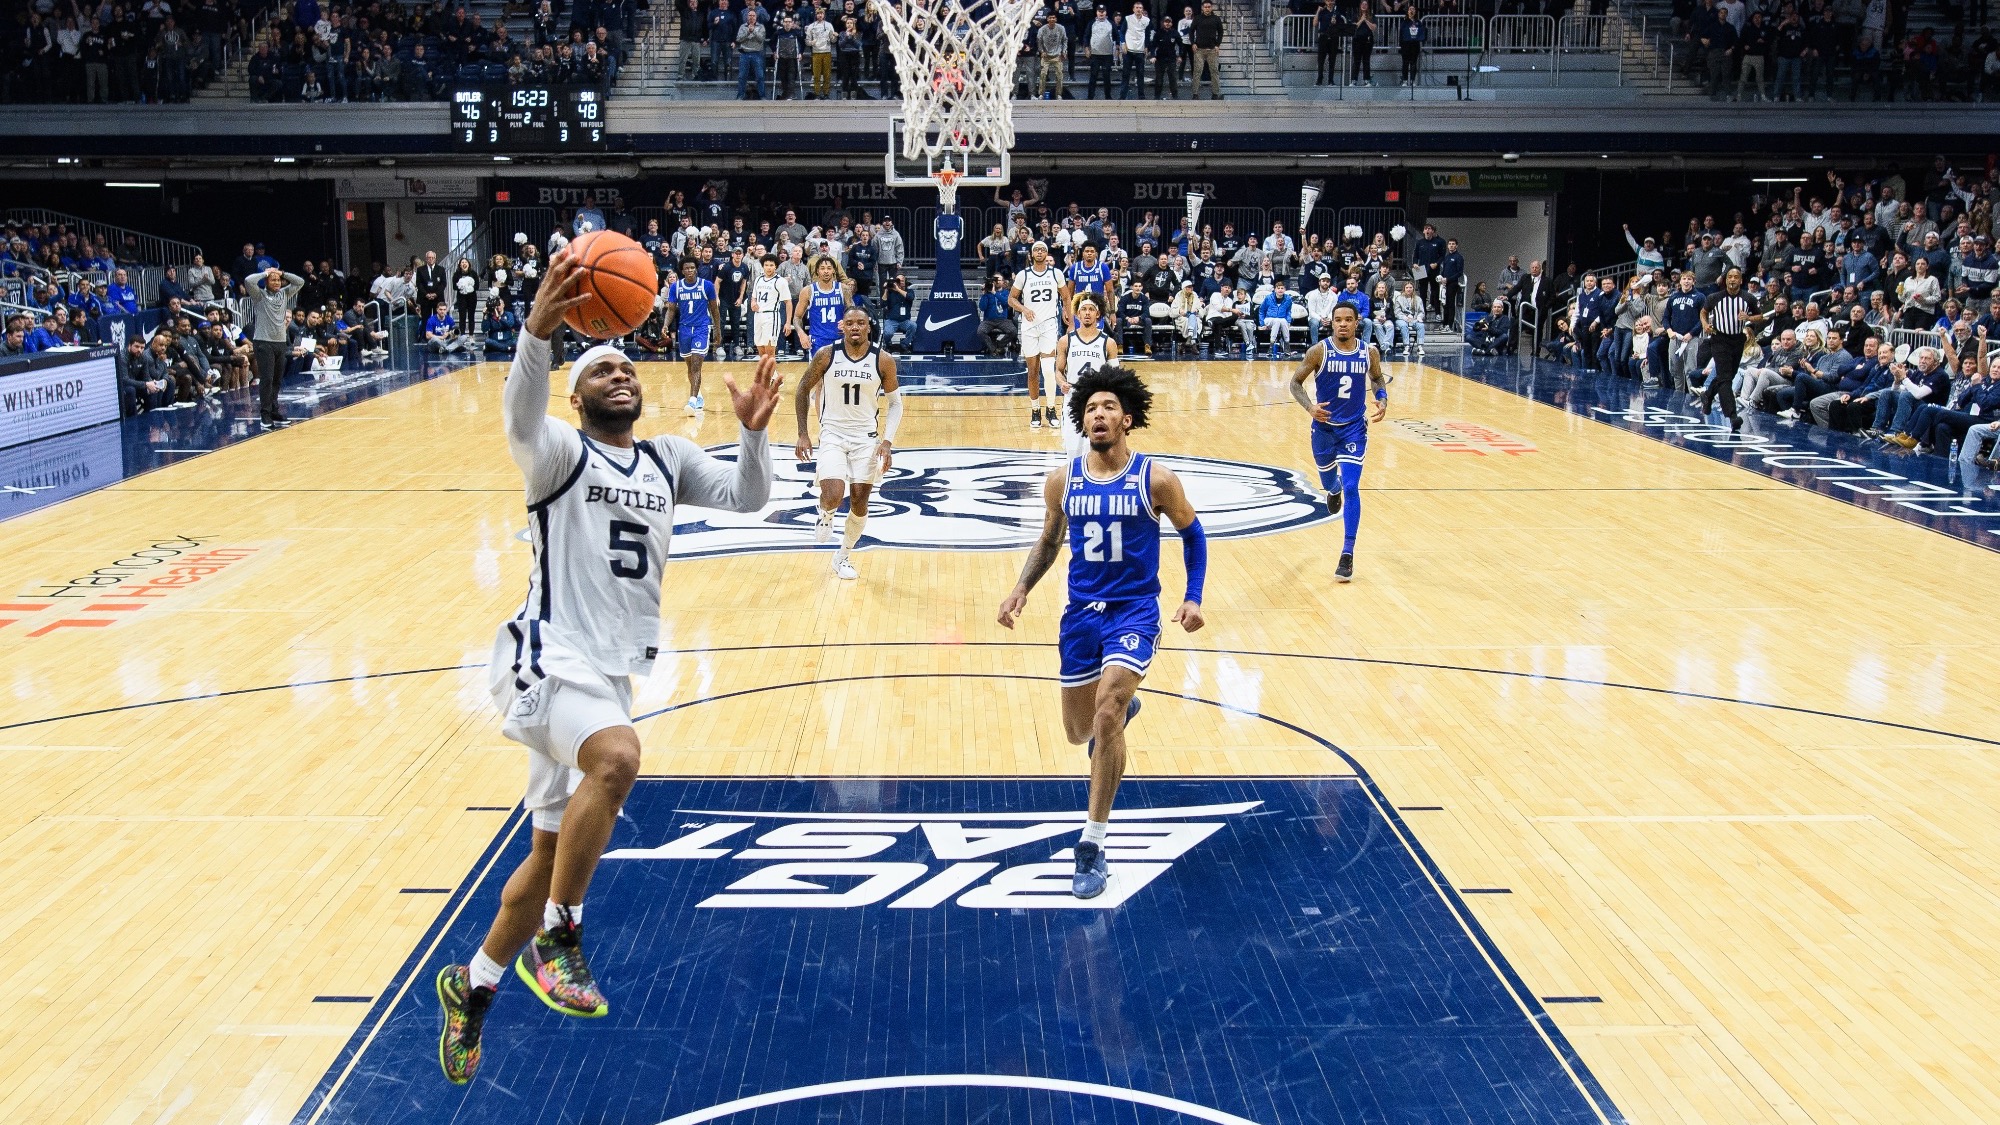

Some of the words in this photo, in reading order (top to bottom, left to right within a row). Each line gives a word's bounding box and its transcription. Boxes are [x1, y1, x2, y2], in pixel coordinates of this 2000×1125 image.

[456, 92, 482, 102] BUTLER
[512, 90, 548, 107] 15:23
[580, 92, 594, 102] SHU
[461, 105, 480, 119] 46
[524, 112, 531, 124] 2
[578, 103, 598, 119] 48
[465, 130, 473, 142] 3
[490, 130, 498, 142] 3
[560, 130, 568, 142] 3
[592, 130, 600, 142] 5
[1479, 173, 1502, 181] Always
[1503, 173, 1529, 181] Working
[538, 187, 620, 204] BUTLER
[814, 183, 897, 200] BUTLER
[1133, 182, 1217, 200] BUTLER
[1344, 257, 1351, 265] 5
[1793, 254, 1816, 264] BUTLER
[1085, 283, 1093, 293] 4
[757, 291, 769, 303] 14
[1030, 289, 1053, 303] 23
[1673, 297, 1694, 307] BUTLER
[687, 301, 694, 314] 1
[820, 307, 836, 323] 14
[1071, 350, 1101, 359] BUTLER
[1077, 361, 1094, 375] 4
[1327, 360, 1347, 373] SETON
[1350, 361, 1366, 374] HALL
[833, 369, 872, 380] BUTLER
[841, 383, 861, 405] 11
[1337, 375, 1353, 399] 2
[3, 379, 84, 412] WINTHROP
[585, 485, 667, 514] BUTLER
[1069, 495, 1101, 516] SETON
[1109, 495, 1138, 516] HALL
[1083, 521, 1123, 563] 21
[609, 519, 649, 580] 5
[17, 534, 220, 598] Hancock
[100, 548, 260, 598] Health
[600, 822, 1226, 859] EAST
[694, 862, 1173, 909] BIG
